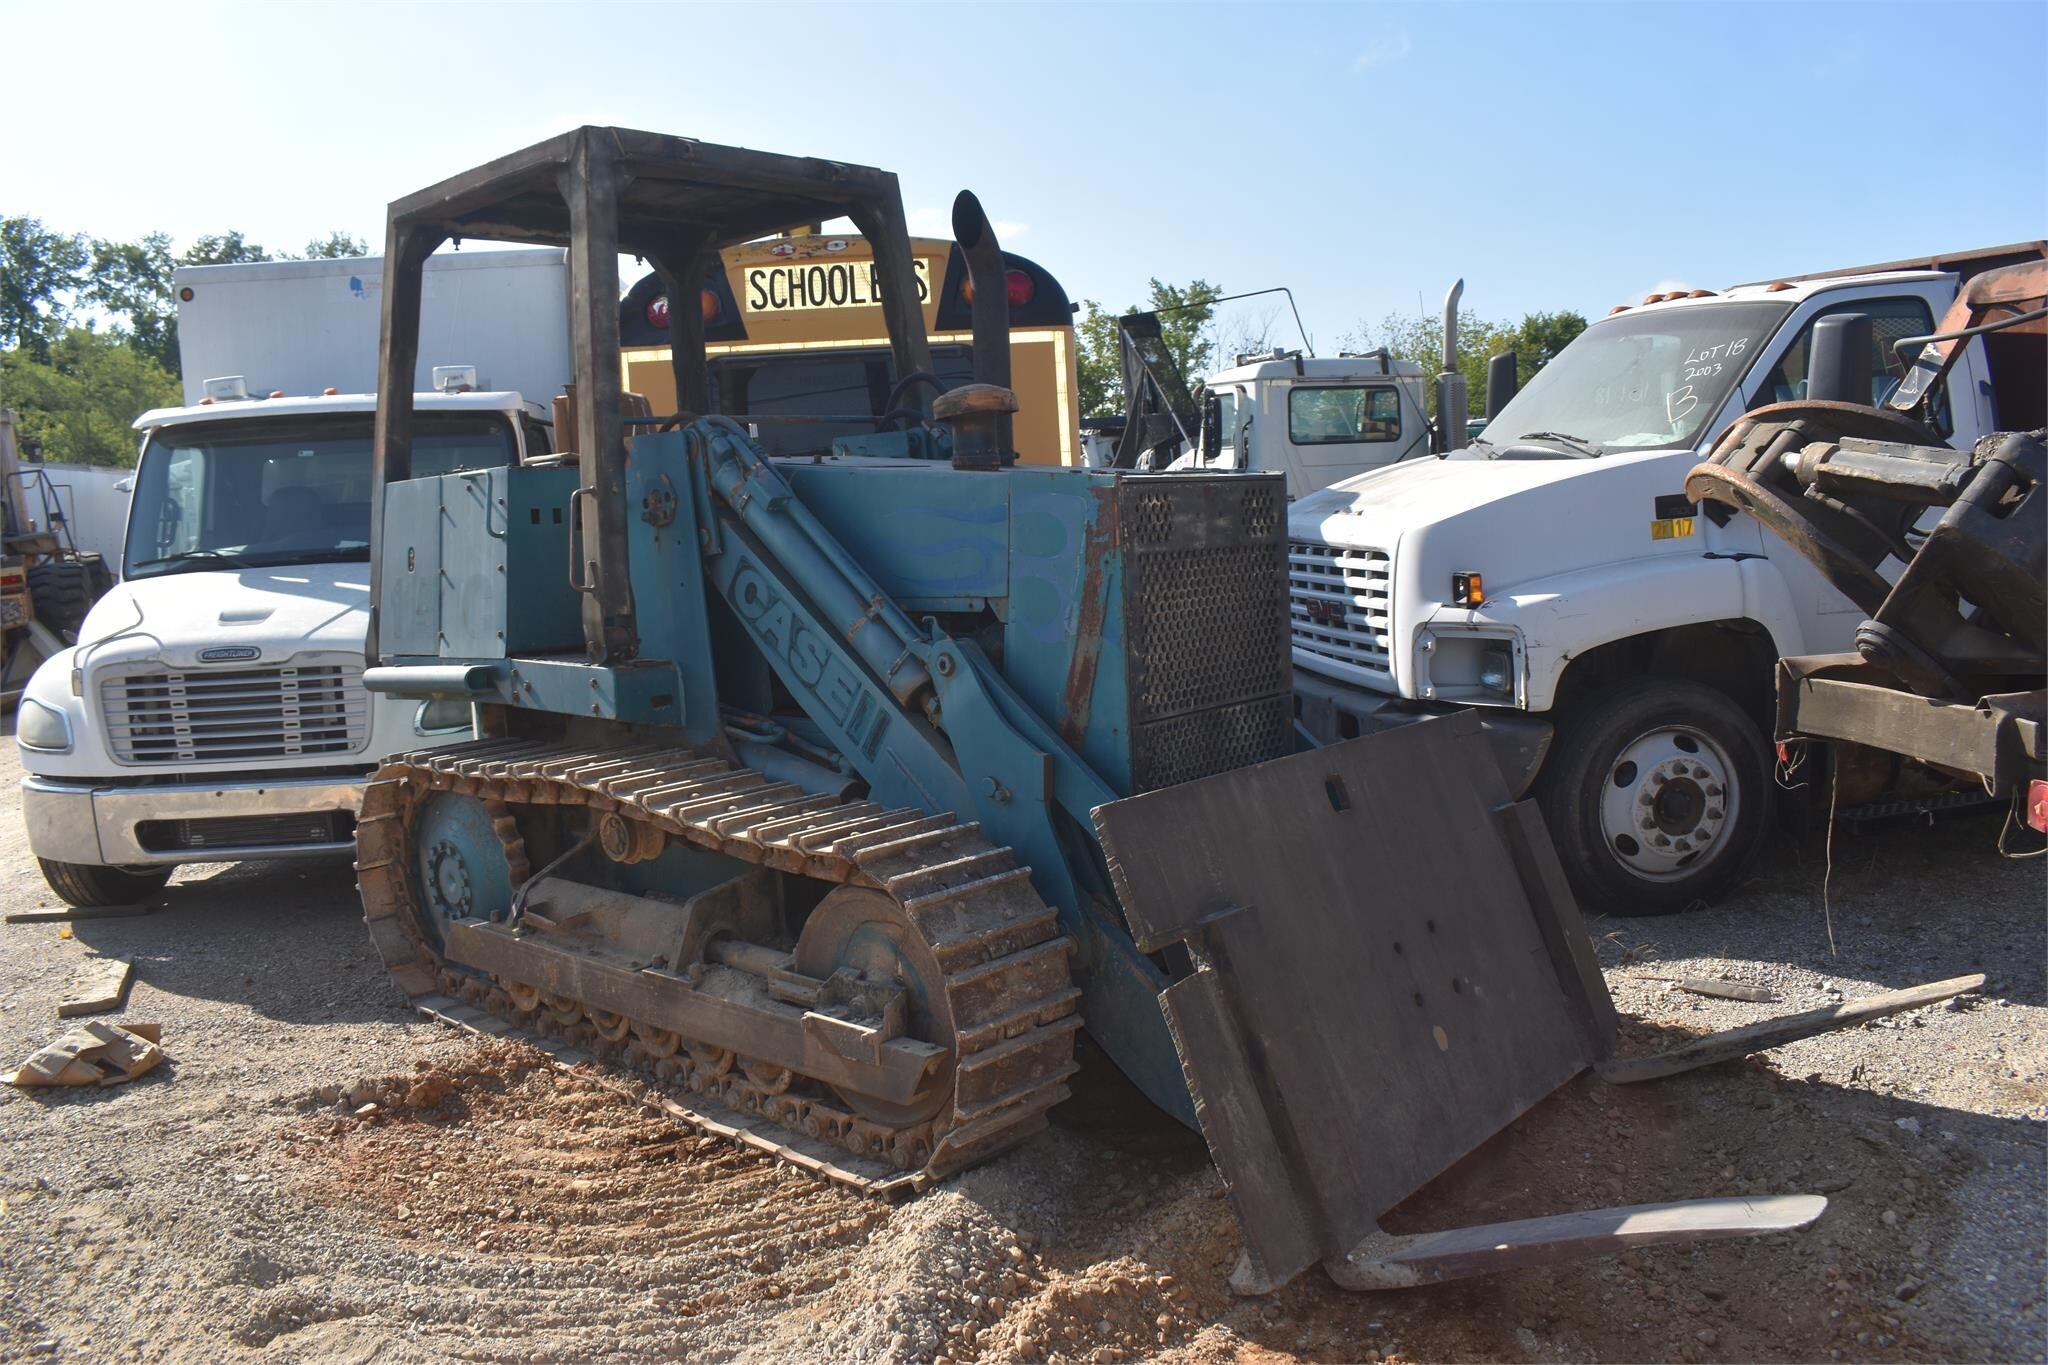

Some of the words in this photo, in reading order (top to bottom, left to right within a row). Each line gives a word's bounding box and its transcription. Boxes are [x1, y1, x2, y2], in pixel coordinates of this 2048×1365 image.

[750, 265, 866, 310] SCHOOL
[1684, 344, 1725, 365] LOT
[1725, 337, 1749, 357] 18
[1685, 363, 1722, 381] 2003
[1306, 598, 1343, 618] GMC
[727, 555, 862, 728] CASE
